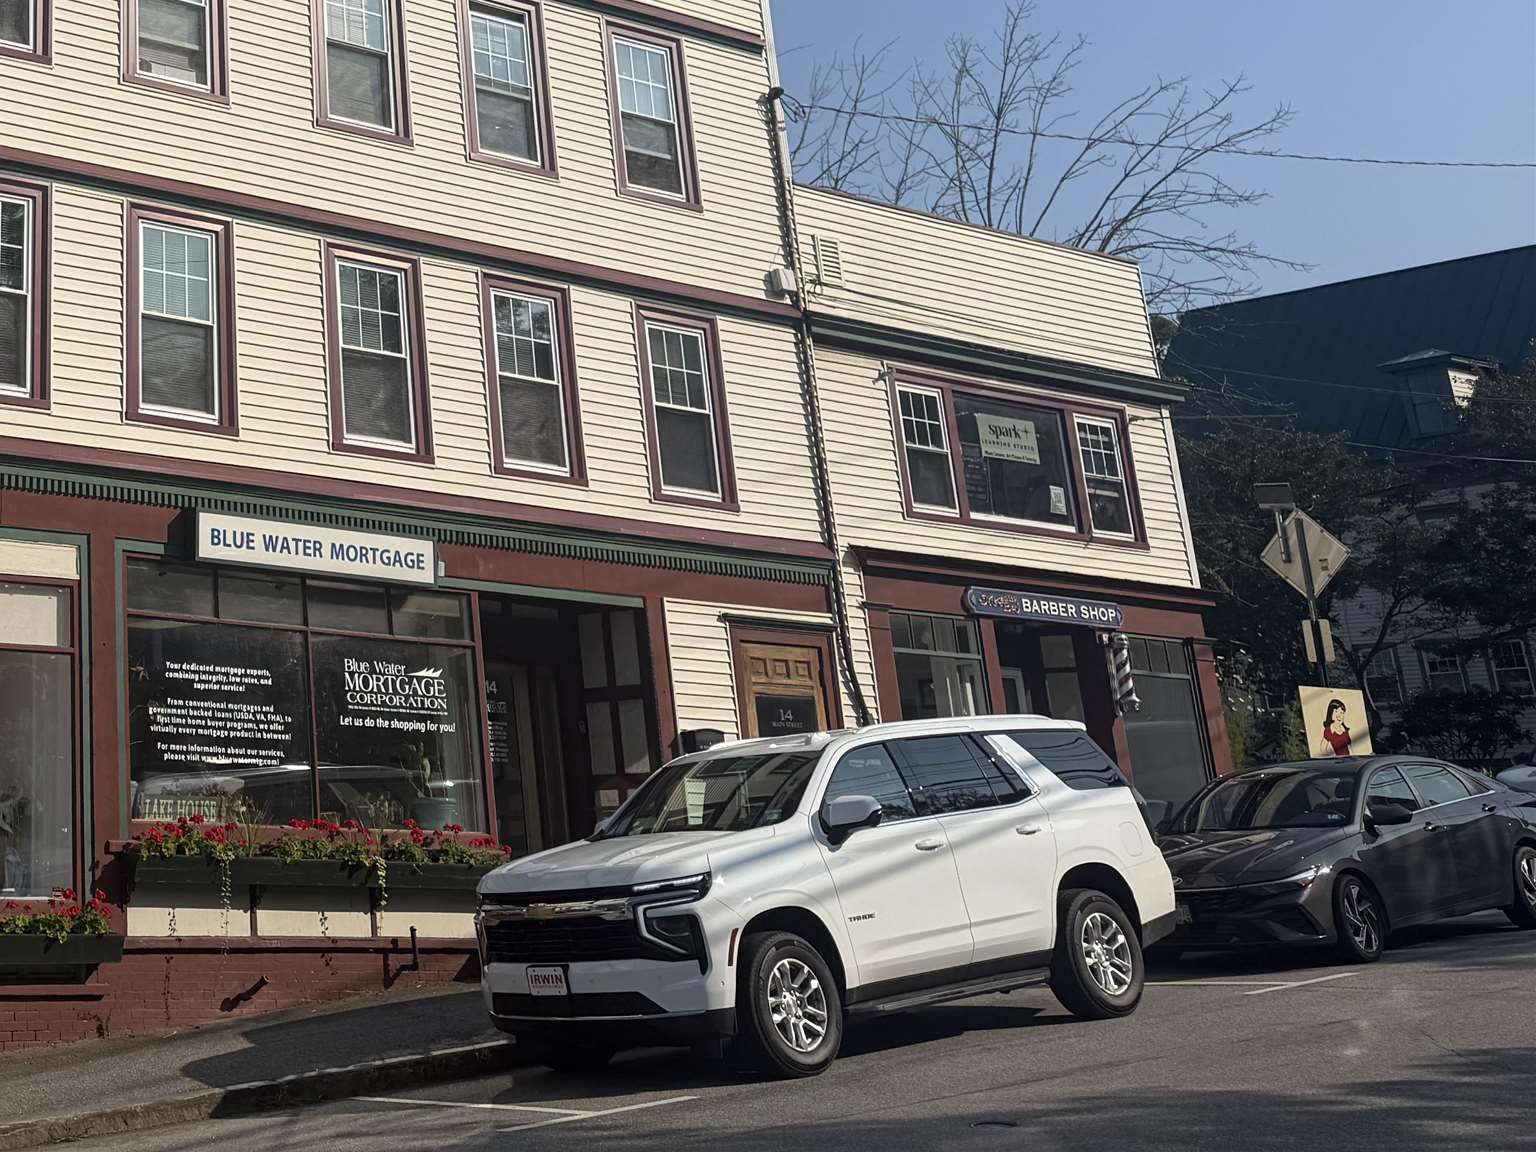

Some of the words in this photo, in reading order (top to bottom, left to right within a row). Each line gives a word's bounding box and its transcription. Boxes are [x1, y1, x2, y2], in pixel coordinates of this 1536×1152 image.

[210, 528, 255, 550] BLUE
[262, 534, 323, 559] WATER
[331, 542, 426, 570] MORTGAGE
[1022, 598, 1078, 618] BARBER
[1080, 605, 1117, 622] SHOP
[166, 661, 181, 669] Your
[182, 662, 214, 672] dedicated
[215, 665, 245, 675] mortgage
[344, 658, 370, 673] Blue
[374, 660, 406, 676] Water
[165, 671, 199, 681] combining
[229, 675, 241, 683] low
[260, 677, 272, 685] and
[344, 672, 447, 697] MORTGAGE
[193, 682, 220, 691] superior
[167, 697, 184, 706] From
[185, 699, 227, 709] conventional
[228, 703, 261, 712] mortgages
[346, 691, 447, 709] CORPORATION
[148, 707, 188, 715] government
[189, 708, 213, 717] backed
[214, 710, 232, 718] loans
[233, 711, 255, 721] (USDA,
[256, 713, 266, 721] VA,
[779, 709, 793, 721] 14
[156, 715, 170, 725] first
[171, 716, 186, 724] time
[187, 717, 205, 726] home
[207, 719, 225, 728] buyer
[226, 721, 258, 730] programs,
[269, 723, 284, 731] offer
[340, 715, 353, 726] Let
[354, 718, 363, 727] us
[364, 716, 375, 727] do
[376, 717, 389, 728] the
[390, 718, 426, 733] shopping
[427, 721, 438, 731] for
[439, 723, 456, 734] you!
[150, 724, 177, 734] virtually
[178, 726, 196, 735] every
[197, 728, 228, 737] mortgage
[229, 730, 254, 738] product
[255, 731, 262, 739] in
[262, 731, 292, 741] between!
[157, 742, 168, 750] For
[169, 743, 187, 751] more
[188, 744, 226, 753] information
[227, 746, 245, 755] about
[246, 748, 258, 756] our
[164, 751, 185, 761] please
[186, 753, 200, 761] visit
[145, 799, 173, 820] LAKE
[177, 799, 217, 822] HOUSE
[848, 913, 875, 923] TAHOE
[529, 974, 564, 985] IRWIN
